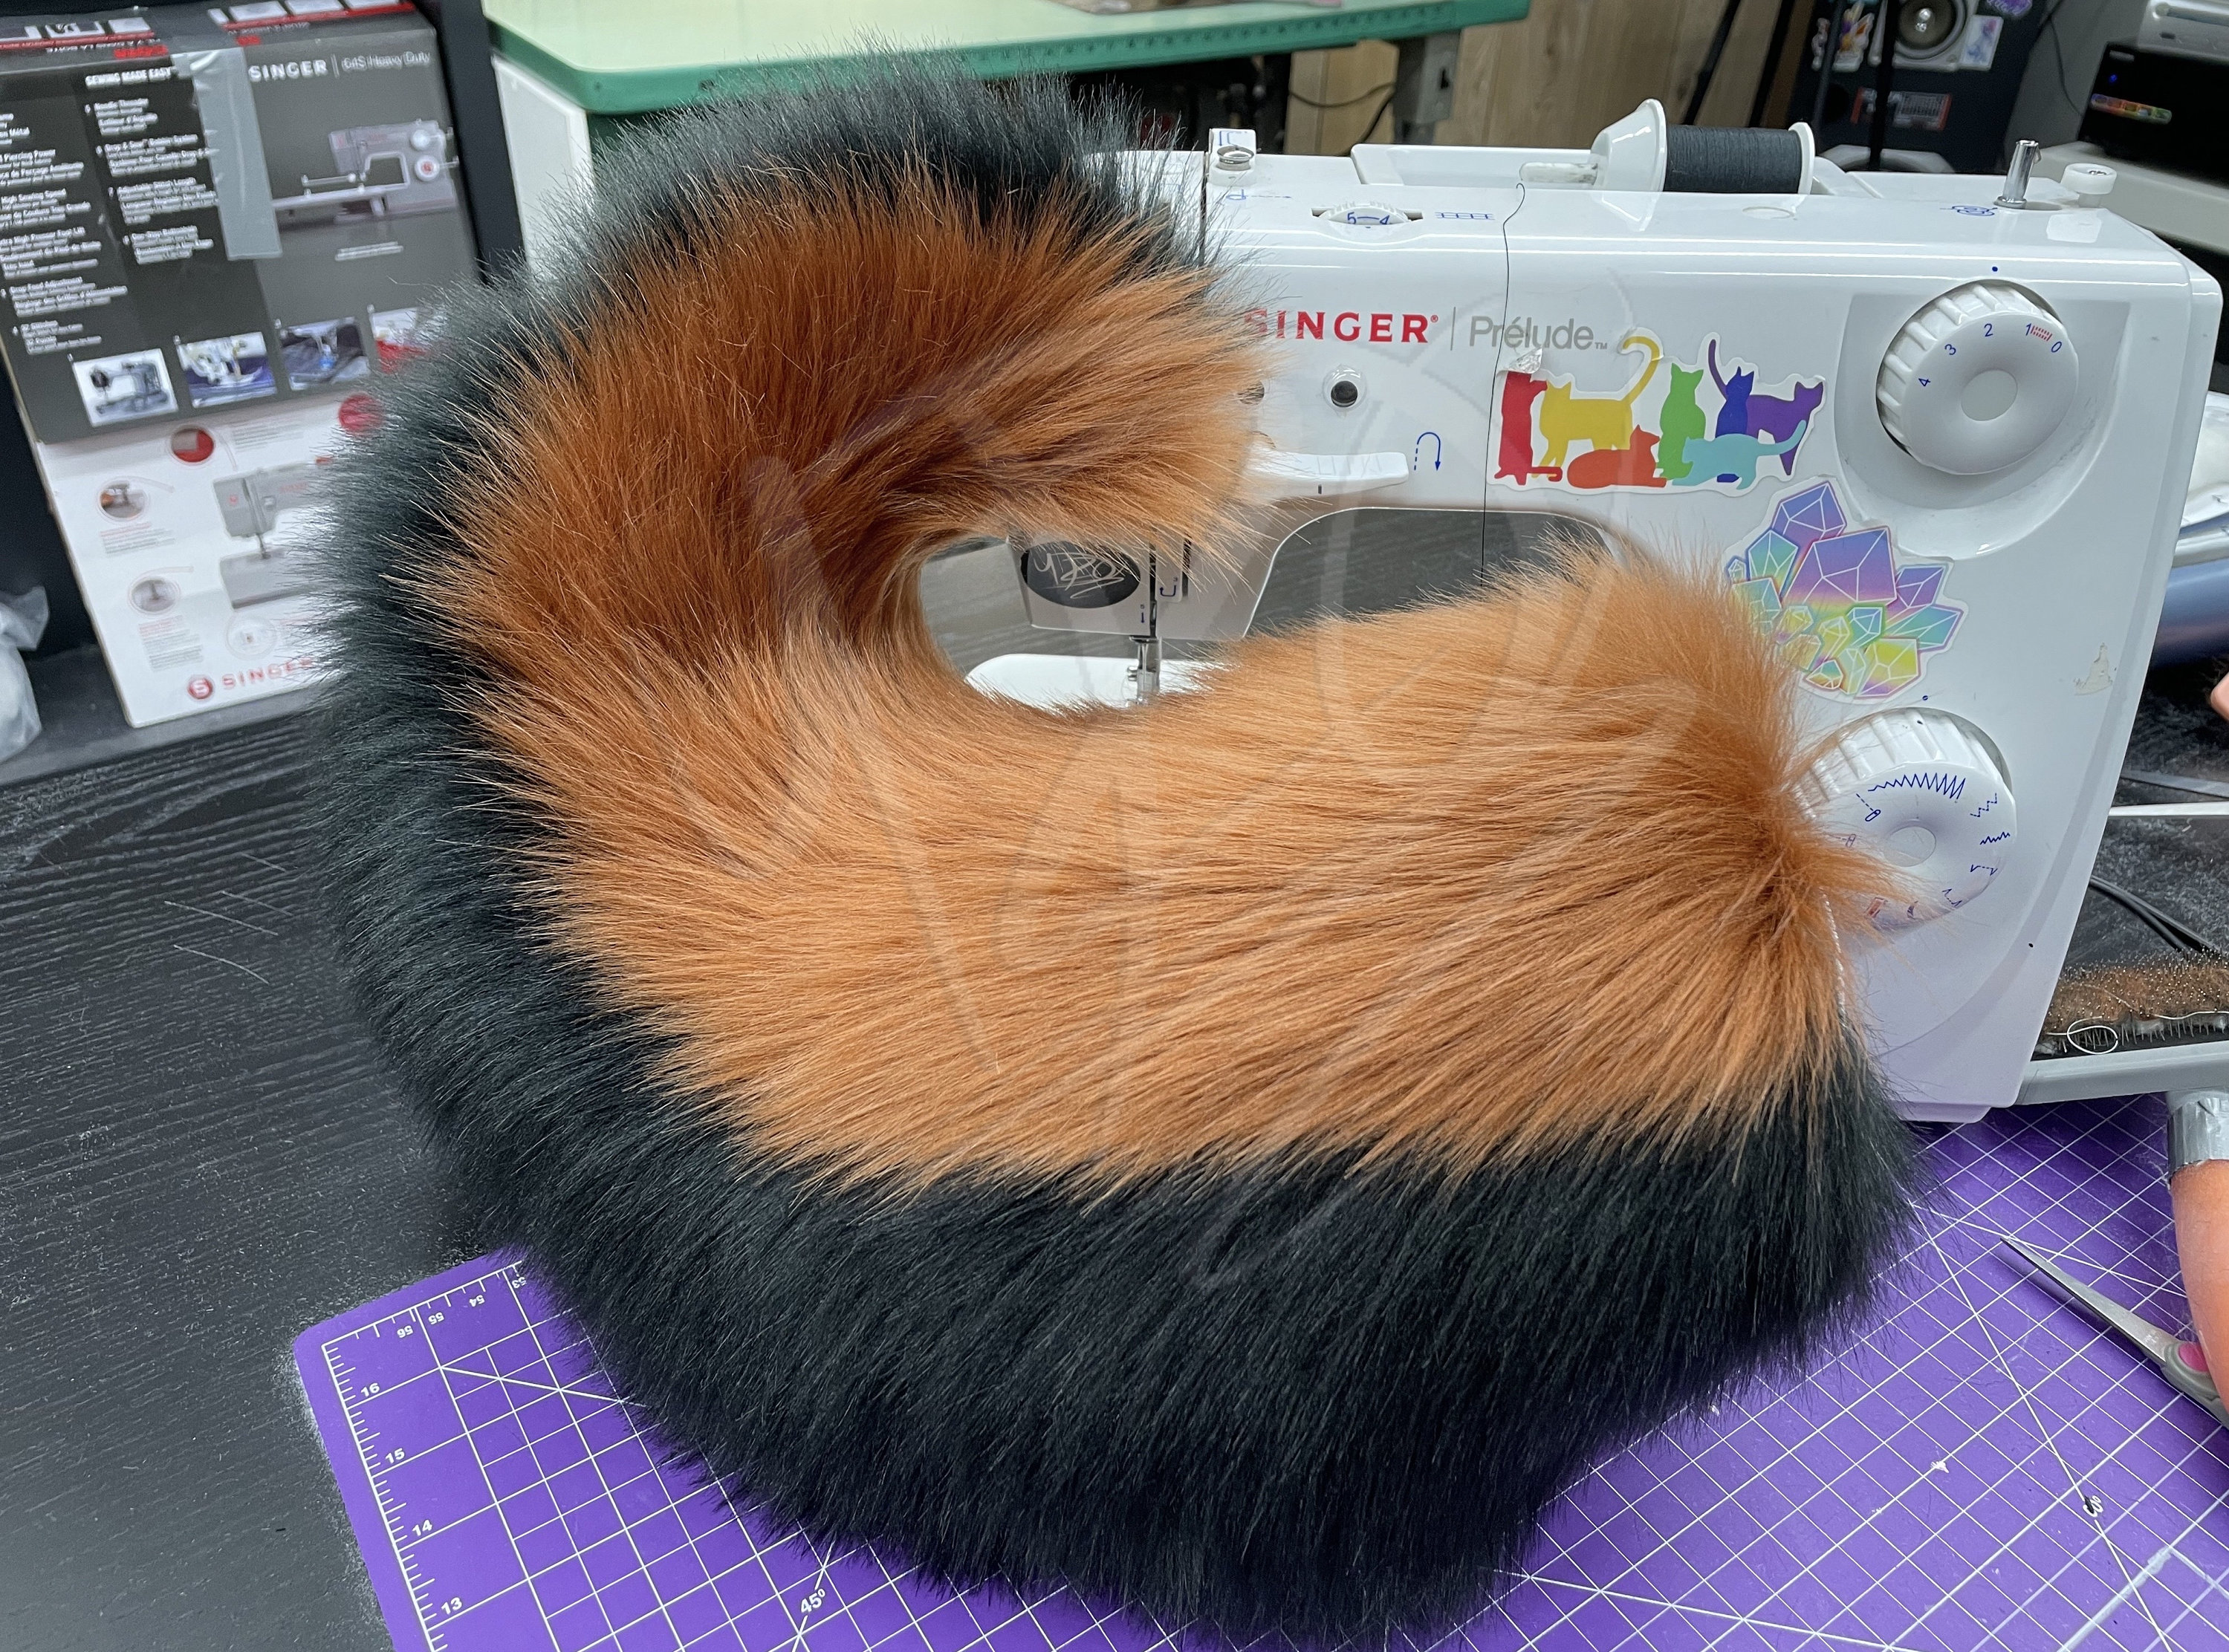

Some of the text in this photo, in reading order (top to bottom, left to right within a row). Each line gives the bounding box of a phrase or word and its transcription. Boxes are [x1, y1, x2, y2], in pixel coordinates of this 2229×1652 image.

[403, 51, 430, 68] Duty
[248, 59, 328, 82] SINGER
[1347, 212, 1357, 224] 5
[1918, 323, 2063, 388] 4 3 2 1 0
[469, 1295, 485, 1307] 54
[428, 1312, 444, 1325] 55
[396, 1325, 414, 1339] 56
[360, 1382, 380, 1397] 16
[385, 1448, 405, 1464] 15
[412, 1520, 433, 1537] 14
[441, 1597, 463, 1615] 13
